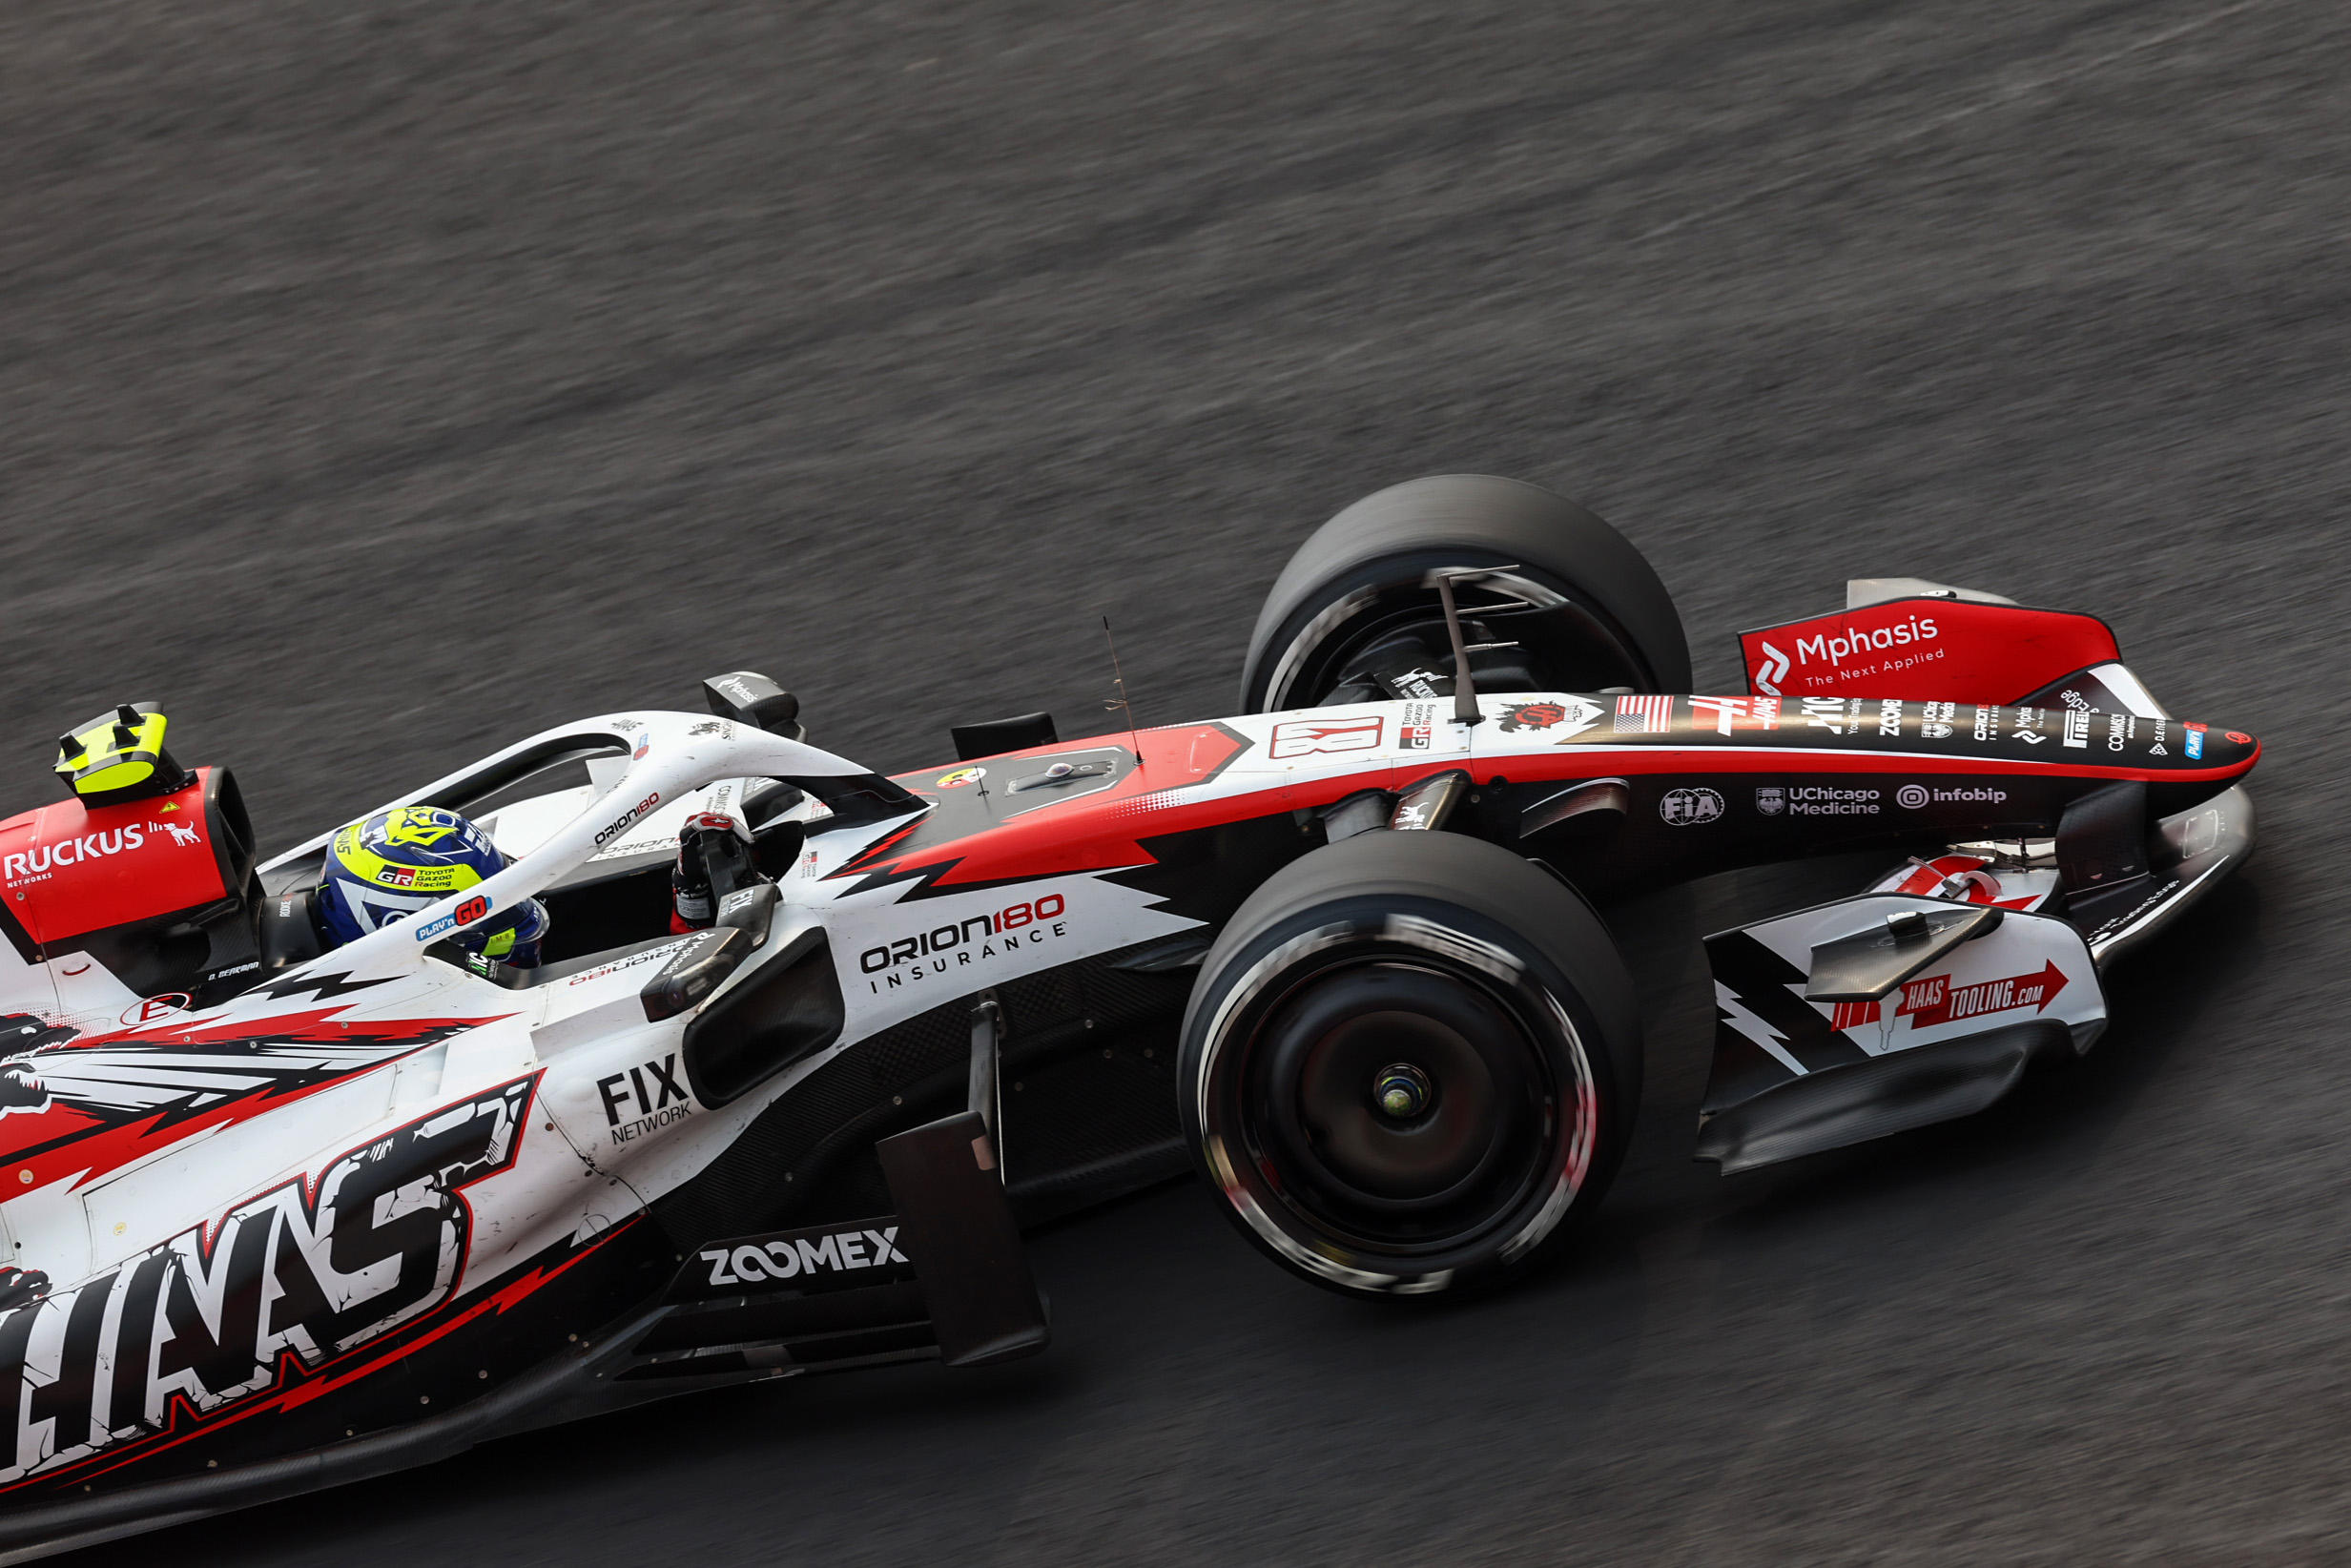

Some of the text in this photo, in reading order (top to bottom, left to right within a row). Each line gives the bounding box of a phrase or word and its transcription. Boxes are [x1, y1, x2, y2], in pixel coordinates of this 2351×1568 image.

[1796, 614, 1939, 665] Mphasis
[1804, 648, 1946, 689] The Next Applied
[1402, 703, 1413, 726] TOYOTA
[1423, 704, 1436, 726] Racing
[1789, 787, 1880, 804] UChicago
[1789, 801, 1880, 816] Medicine
[1932, 787, 2008, 805] infobip
[594, 792, 660, 846] ORION180
[4, 823, 143, 879] RUCKUS
[7, 872, 52, 888] NETWORKS
[378, 872, 413, 887] GR
[419, 868, 455, 877] TOYOTA
[420, 897, 486, 939] PLAY'n GO
[860, 893, 1065, 974] ORION180
[217, 961, 259, 979] BEARMAN
[869, 921, 1067, 994] INSURANCE
[1907, 979, 2043, 1018] HAAS TOOLING.COM
[596, 1053, 689, 1126] FIX
[611, 1103, 691, 1145] NETWORK
[700, 1227, 910, 1287] ZOOMEX
